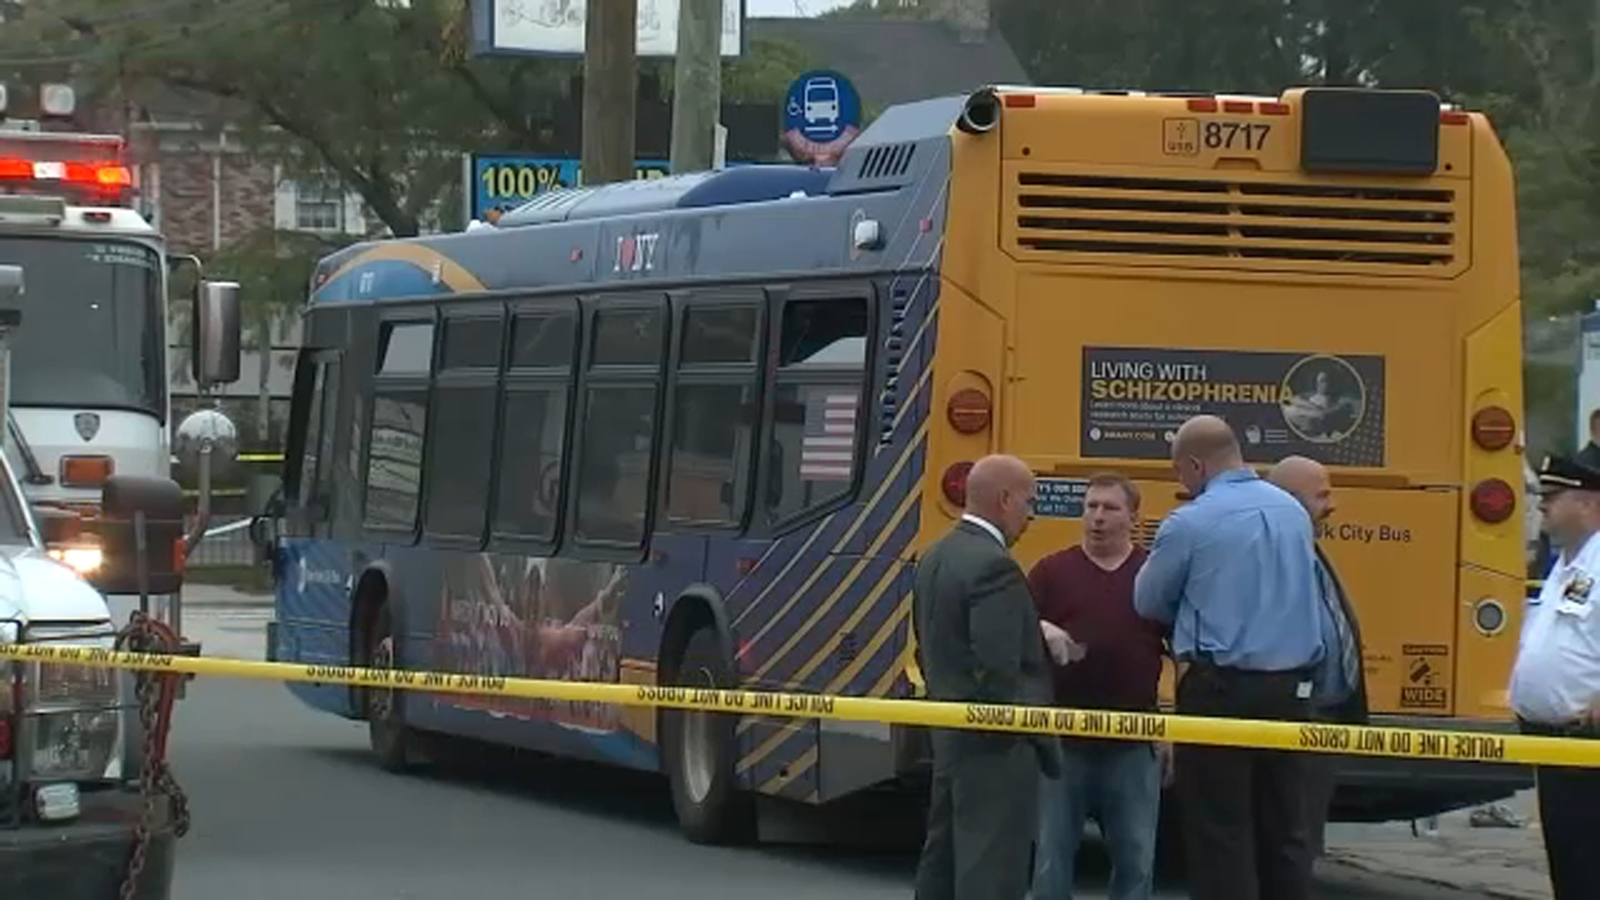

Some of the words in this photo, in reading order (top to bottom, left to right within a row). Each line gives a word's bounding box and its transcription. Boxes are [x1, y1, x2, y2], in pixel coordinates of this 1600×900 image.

[1204, 122, 1271, 150] 8717
[482, 166, 563, 199] 100%
[1091, 362, 1153, 379] LIVING
[1157, 364, 1206, 381] WITH
[1091, 380, 1293, 404] SCHIZOPHRENIA
[1339, 524, 1374, 543] City
[1379, 525, 1411, 542] Bus
[690, 689, 719, 706] NOT
[725, 691, 744, 707] DO
[750, 693, 781, 710] LINE
[785, 694, 834, 713] POLICE
[1404, 689, 1443, 701] WIDE
[966, 706, 1016, 725] CROSS
[1021, 709, 1049, 728] NOT
[1054, 711, 1075, 731] DO
[1080, 712, 1111, 733] LINE
[1116, 715, 1166, 737] POLICE
[1299, 726, 1349, 750] CROSS
[1356, 730, 1384, 750] NOT
[1390, 731, 1411, 753] DO
[1419, 732, 1449, 755] LINE
[1454, 736, 1505, 759] POLICE
